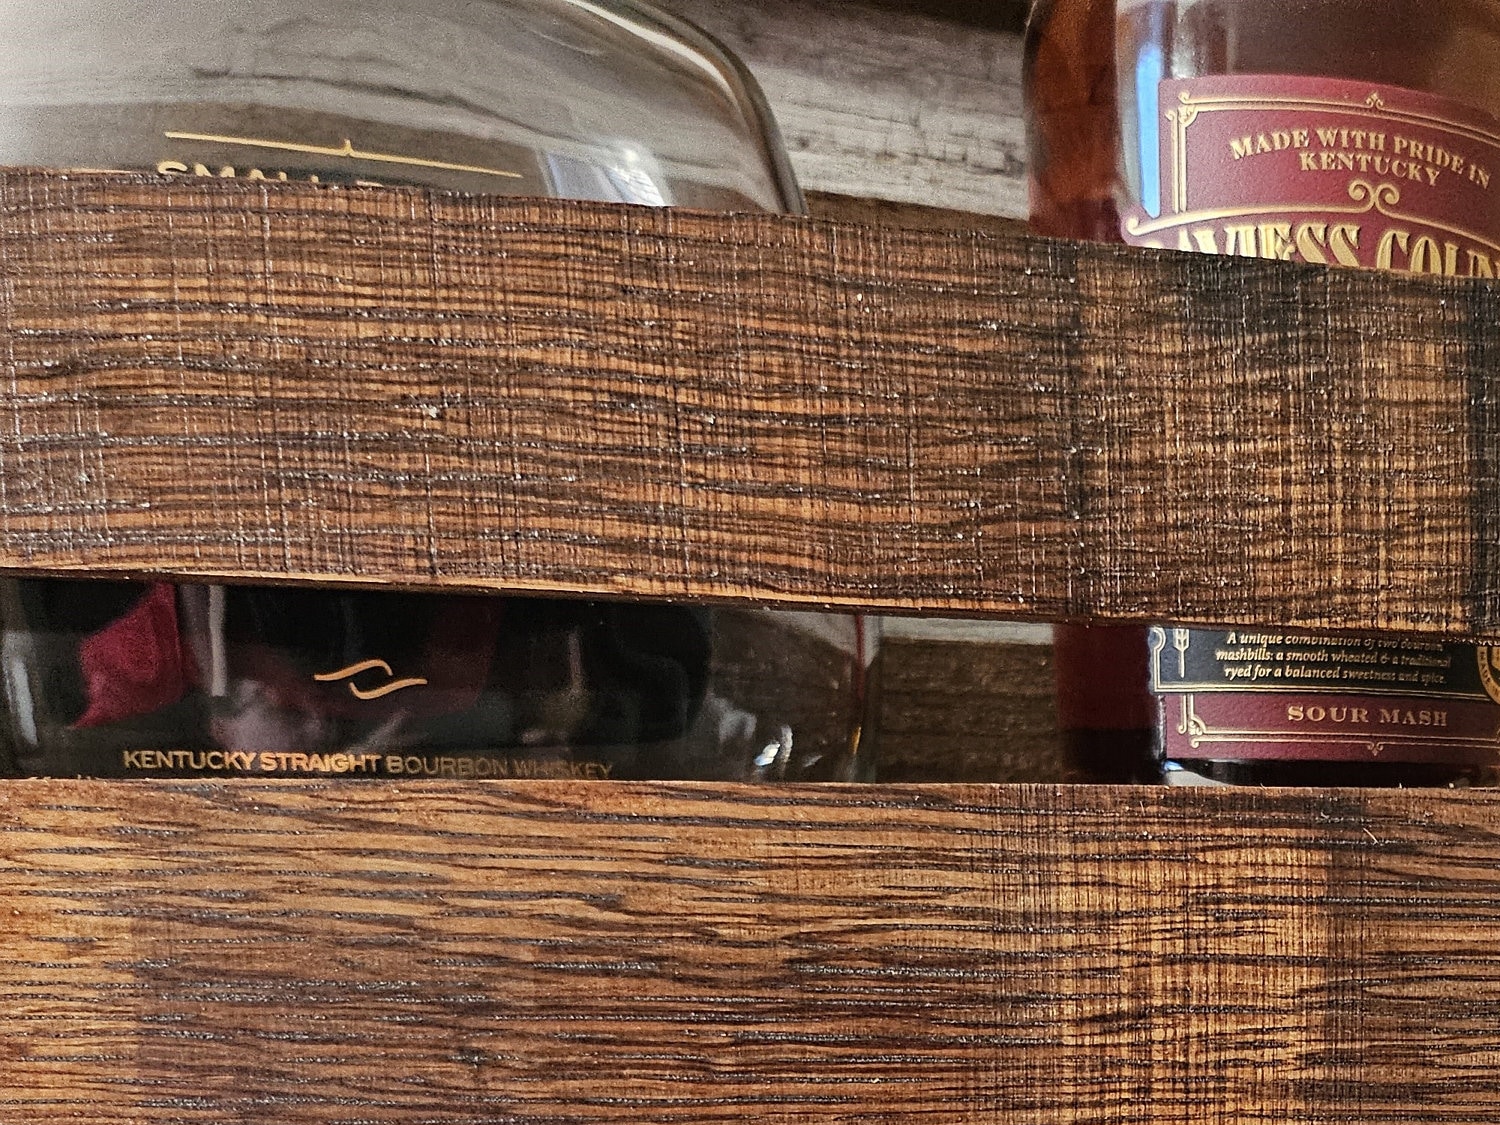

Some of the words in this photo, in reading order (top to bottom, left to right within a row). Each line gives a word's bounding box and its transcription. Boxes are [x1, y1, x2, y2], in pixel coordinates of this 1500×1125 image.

[1230, 129, 1309, 160] MADE
[1316, 128, 1387, 151] WITH
[1394, 136, 1464, 175] PRIDE
[1468, 163, 1491, 190] IN
[1299, 152, 1440, 187] KENTUCKY
[1226, 631, 1237, 645] A
[1240, 632, 1283, 647] unique
[1215, 647, 1273, 661] mashbills:
[1275, 652, 1284, 661] a
[1286, 649, 1328, 662] smooth
[1330, 650, 1378, 664] wheated
[1225, 665, 1252, 681] ryed
[1252, 664, 1272, 680] for
[1274, 668, 1282, 677] a
[1284, 665, 1340, 679] balanced
[1342, 669, 1396, 682] sweetness
[1287, 705, 1369, 723] SOUR
[1379, 707, 1448, 727] MASH
[123, 751, 256, 770] KENTUCKY
[259, 752, 382, 772] STRAIGHT
[386, 755, 509, 777] BOURBON
[512, 757, 613, 780] WHISKEY
